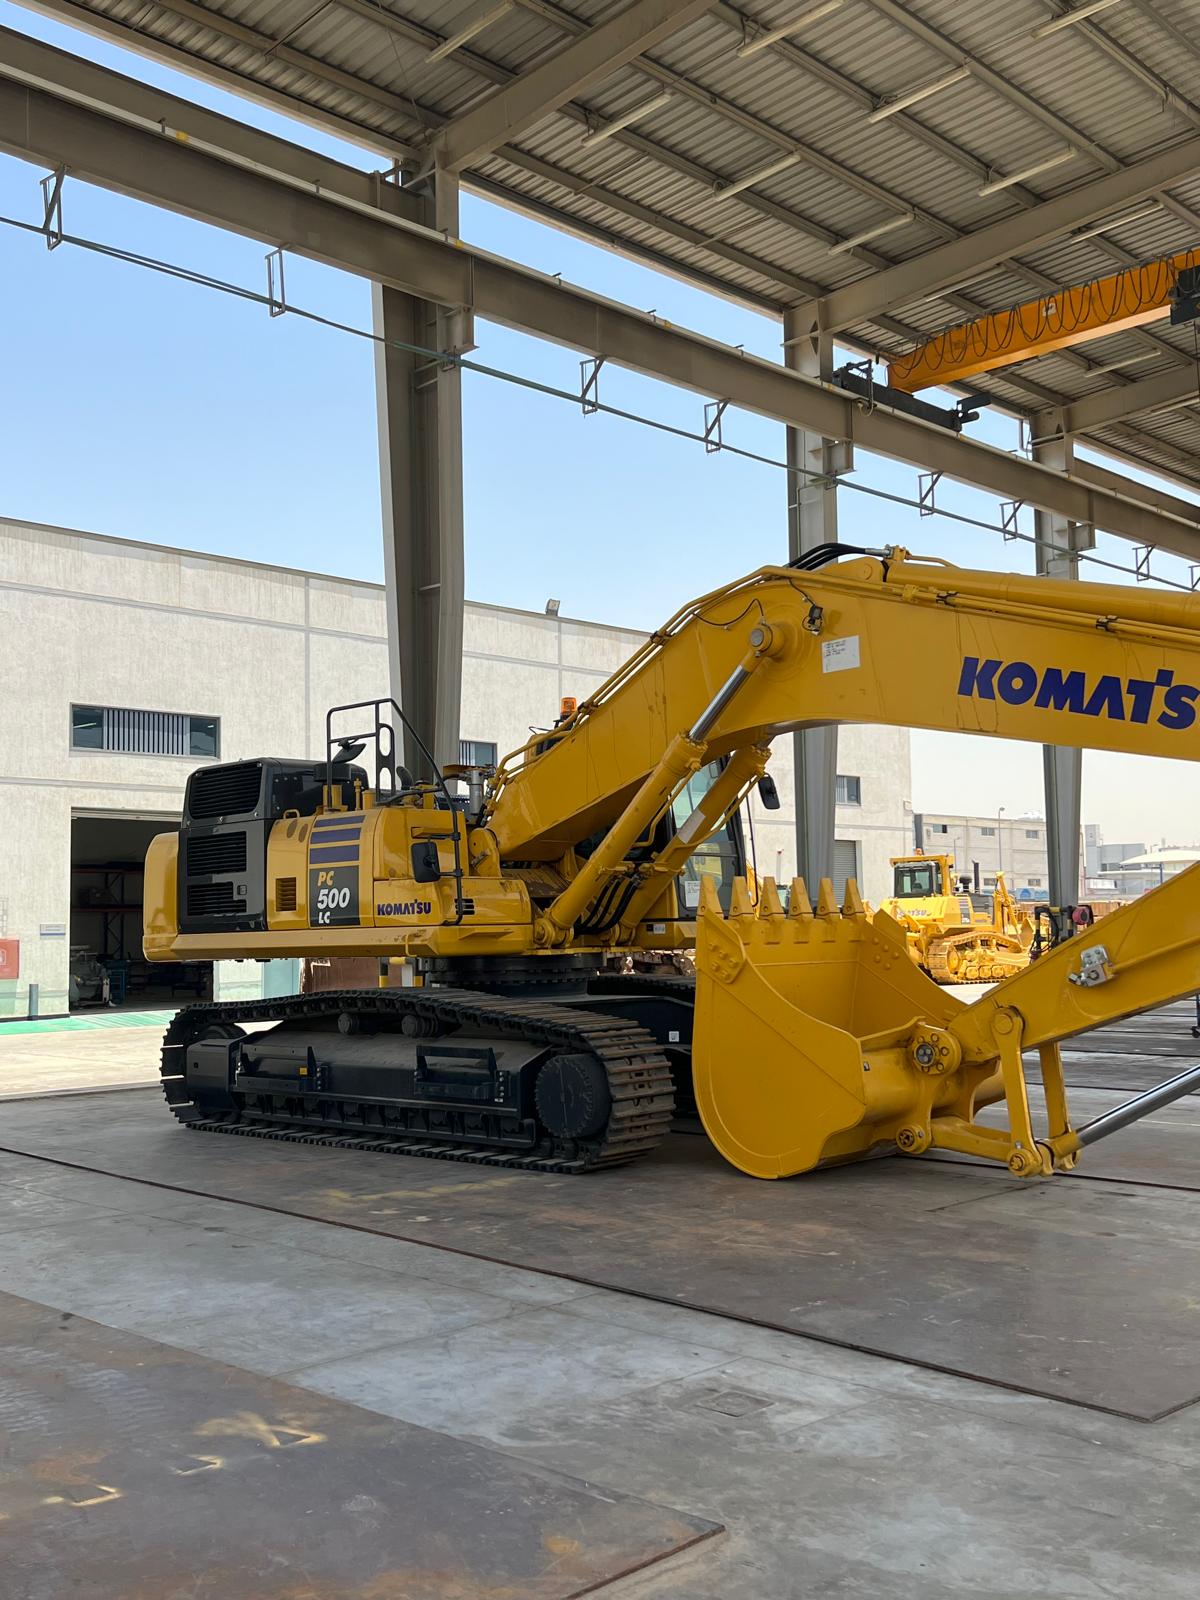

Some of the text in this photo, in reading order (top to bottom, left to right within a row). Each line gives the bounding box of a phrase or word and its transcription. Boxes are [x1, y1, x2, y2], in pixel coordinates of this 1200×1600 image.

[317, 870, 335, 887] PC
[317, 887, 351, 910] 500
[377, 899, 431, 916] KOMATSU
[318, 911, 331, 924] LC
